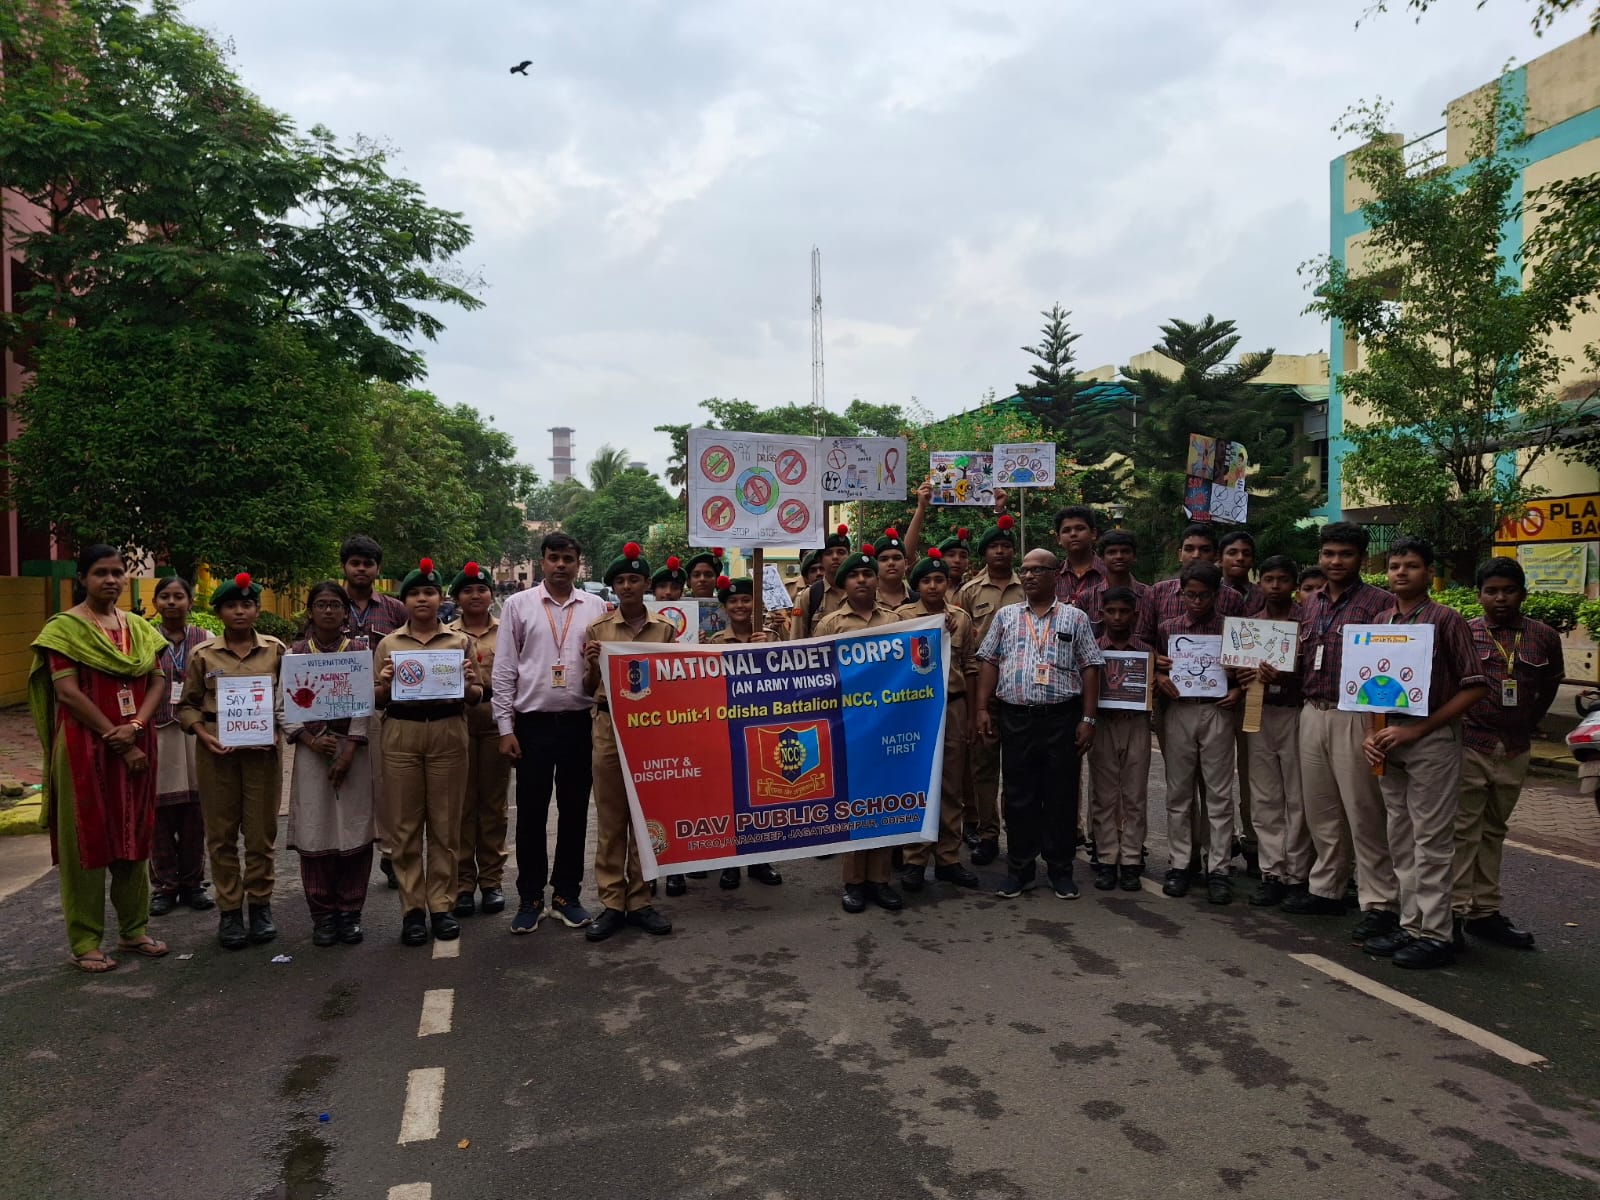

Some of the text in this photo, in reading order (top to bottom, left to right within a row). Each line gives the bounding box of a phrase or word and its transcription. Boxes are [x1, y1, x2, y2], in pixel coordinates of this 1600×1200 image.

[732, 442, 751, 452] SAY
[732, 528, 750, 536] STOP
[1571, 519, 1600, 535] BA
[656, 638, 904, 681] NATIONAL CADET CORPS
[1223, 654, 1239, 665] NO
[320, 673, 350, 681] AGAINST
[732, 673, 837, 698] (AN ARMY WINGS)
[226, 695, 247, 706] SAY
[627, 685, 934, 728] NCC Unit-1 Odisha Battalion NCC, Cuttack
[227, 708, 243, 717] NO
[226, 720, 268, 732] DRUGS
[881, 731, 921, 746] NATION
[781, 746, 800, 763] NCC
[886, 743, 917, 756] FIRST
[643, 756, 692, 770] UNITY &
[634, 767, 702, 783] DISCIPLINE
[675, 815, 731, 839] DAV
[736, 804, 829, 832] PUBLIC
[834, 790, 928, 820] SCHOOL
[881, 813, 921, 825] ODISHA
